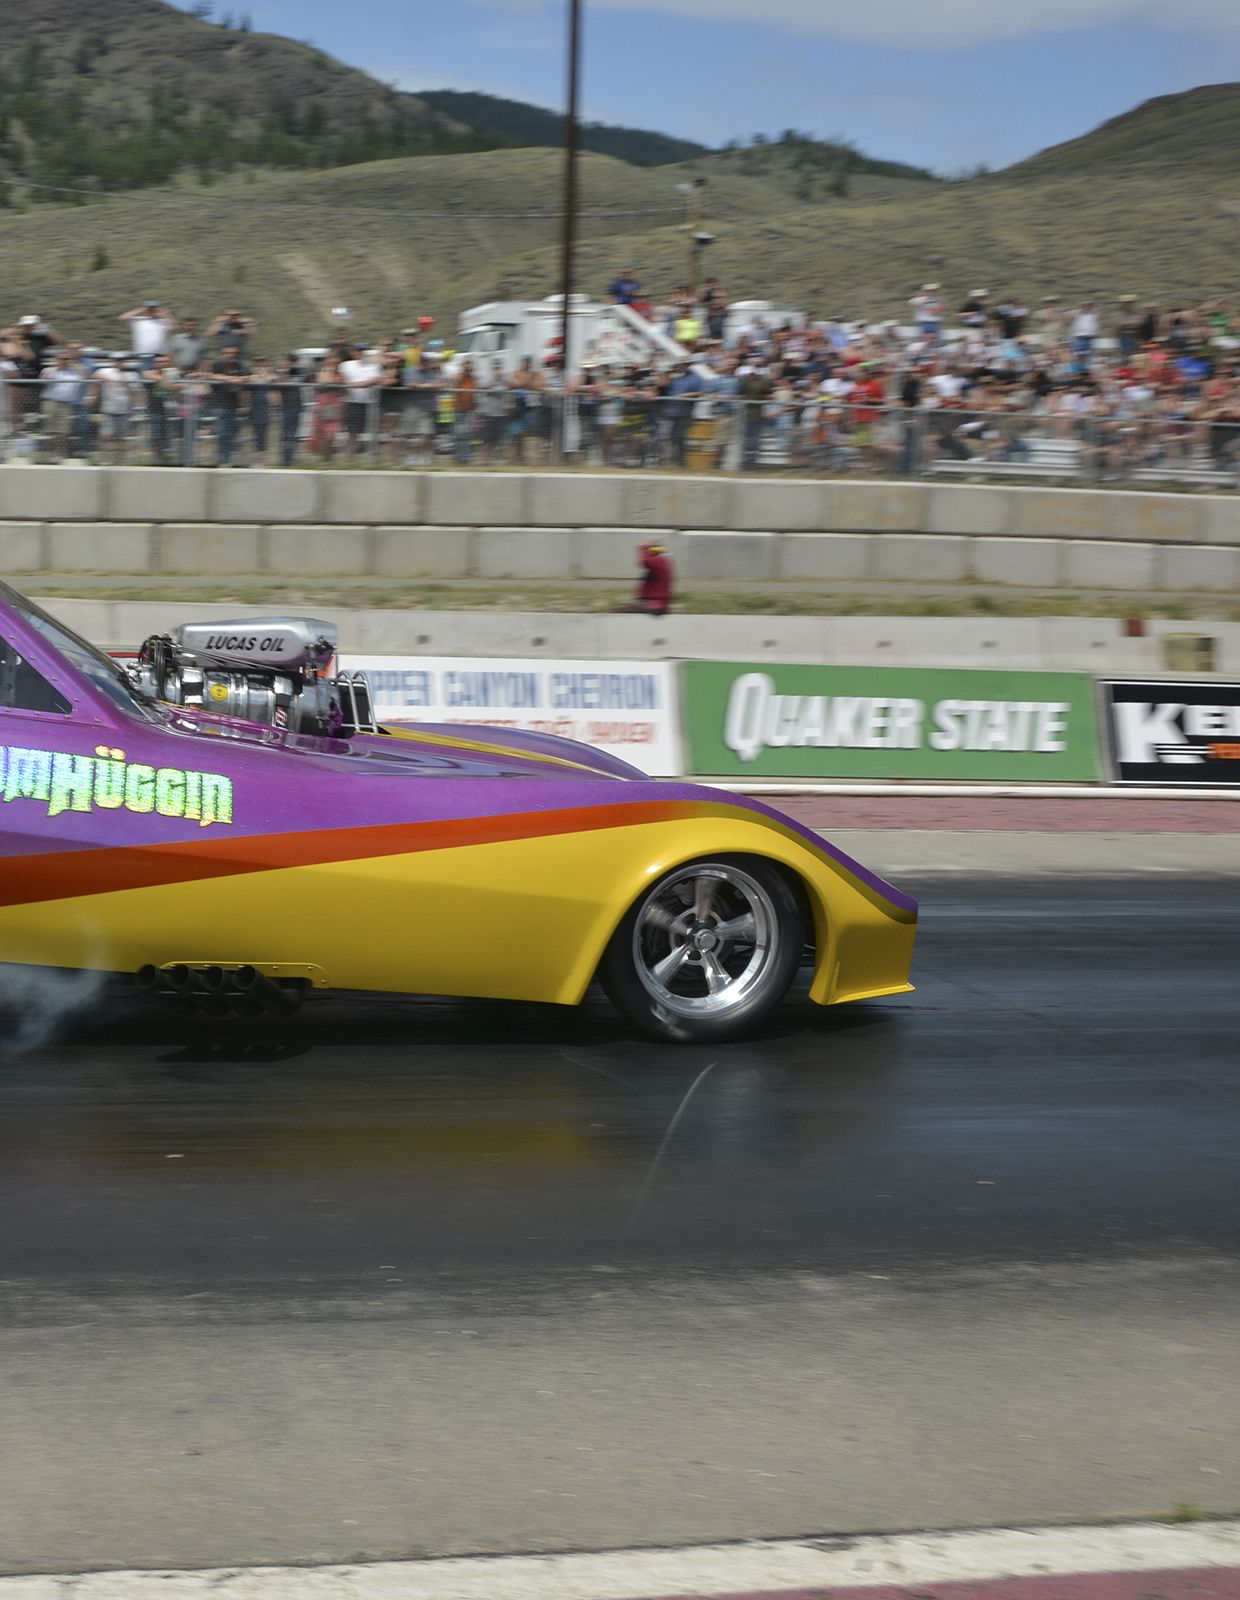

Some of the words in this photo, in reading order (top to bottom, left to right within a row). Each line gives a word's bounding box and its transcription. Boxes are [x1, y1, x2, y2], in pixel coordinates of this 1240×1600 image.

[205, 636, 257, 650] LUCAS
[259, 637, 286, 651] OIL
[443, 671, 540, 707] CANYON
[724, 673, 923, 762] QUAKER
[928, 699, 1070, 753] STATE
[1111, 702, 1240, 764] KE
